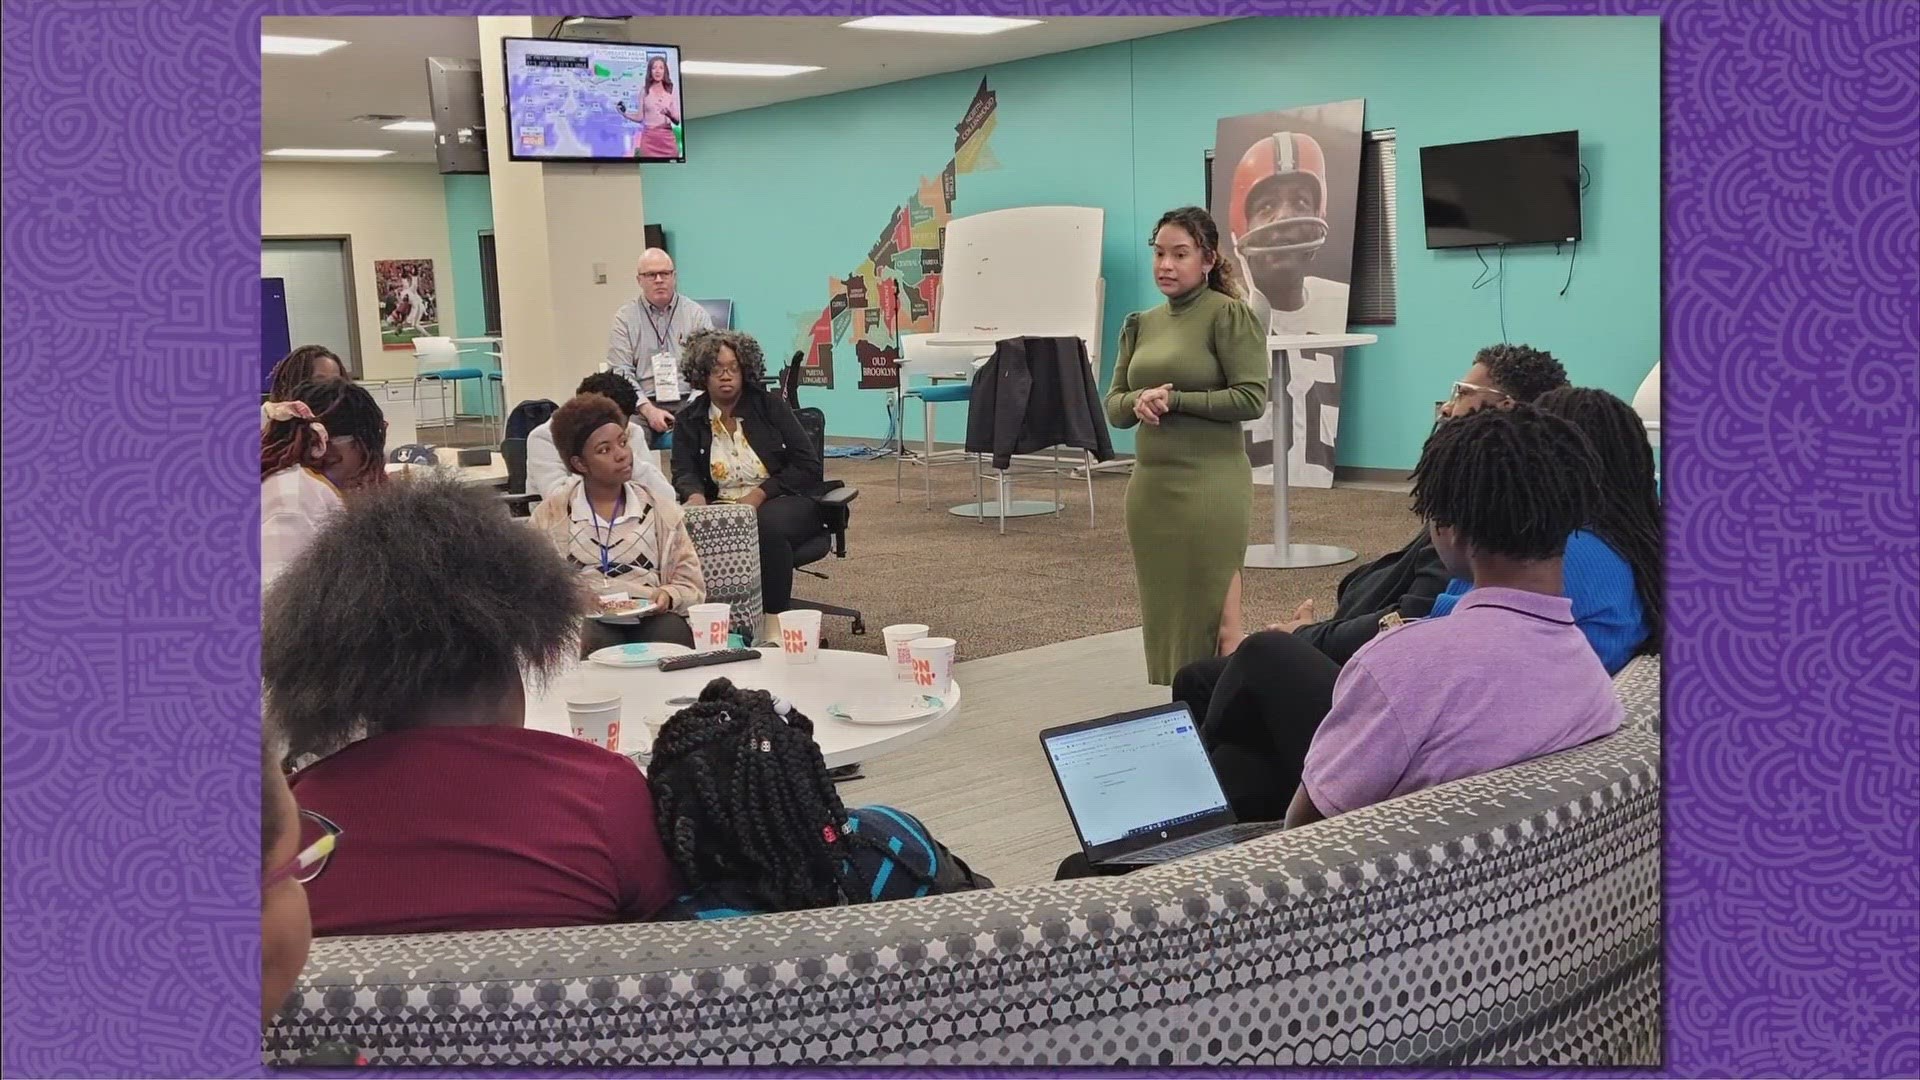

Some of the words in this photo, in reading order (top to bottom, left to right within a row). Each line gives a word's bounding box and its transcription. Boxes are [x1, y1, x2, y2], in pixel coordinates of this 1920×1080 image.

[872, 357, 886, 366] OLD
[863, 367, 897, 377] BROOKLYN
[783, 629, 803, 641] DN
[911, 658, 930, 672] DN
